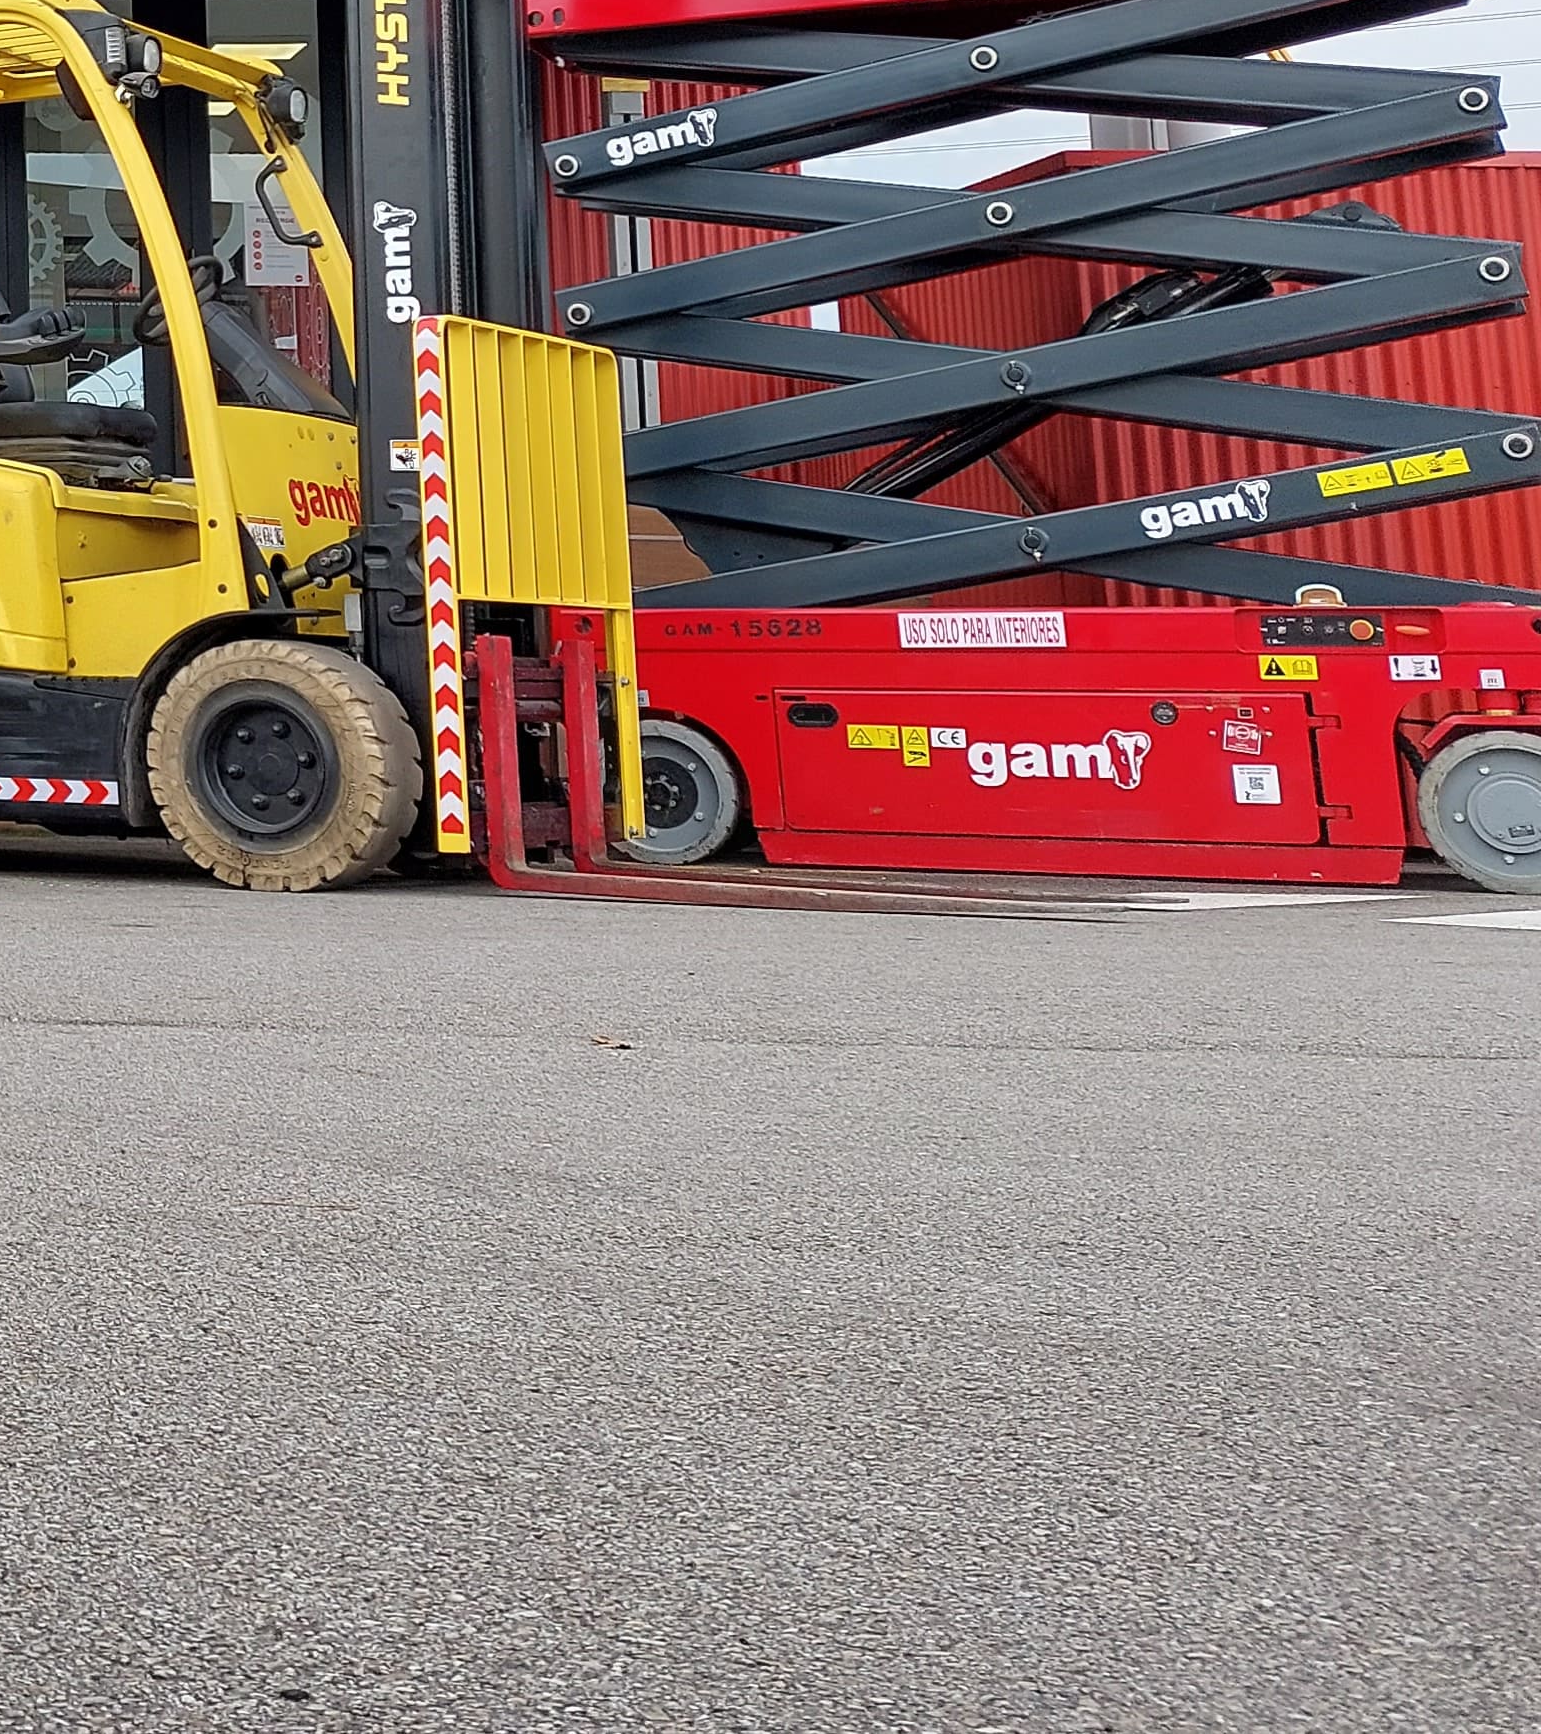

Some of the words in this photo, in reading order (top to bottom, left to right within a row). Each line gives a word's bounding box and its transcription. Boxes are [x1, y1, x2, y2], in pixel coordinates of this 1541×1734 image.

[605, 122, 697, 166] gam
[382, 224, 421, 324] gam
[288, 478, 354, 527] gam
[1140, 492, 1250, 539] gam
[903, 618, 927, 644] USO
[930, 618, 960, 644] SOLO
[963, 618, 992, 644] PARA
[995, 617, 1059, 644] INTERIORES
[937, 730, 960, 746] CE
[967, 741, 1114, 787] gam
